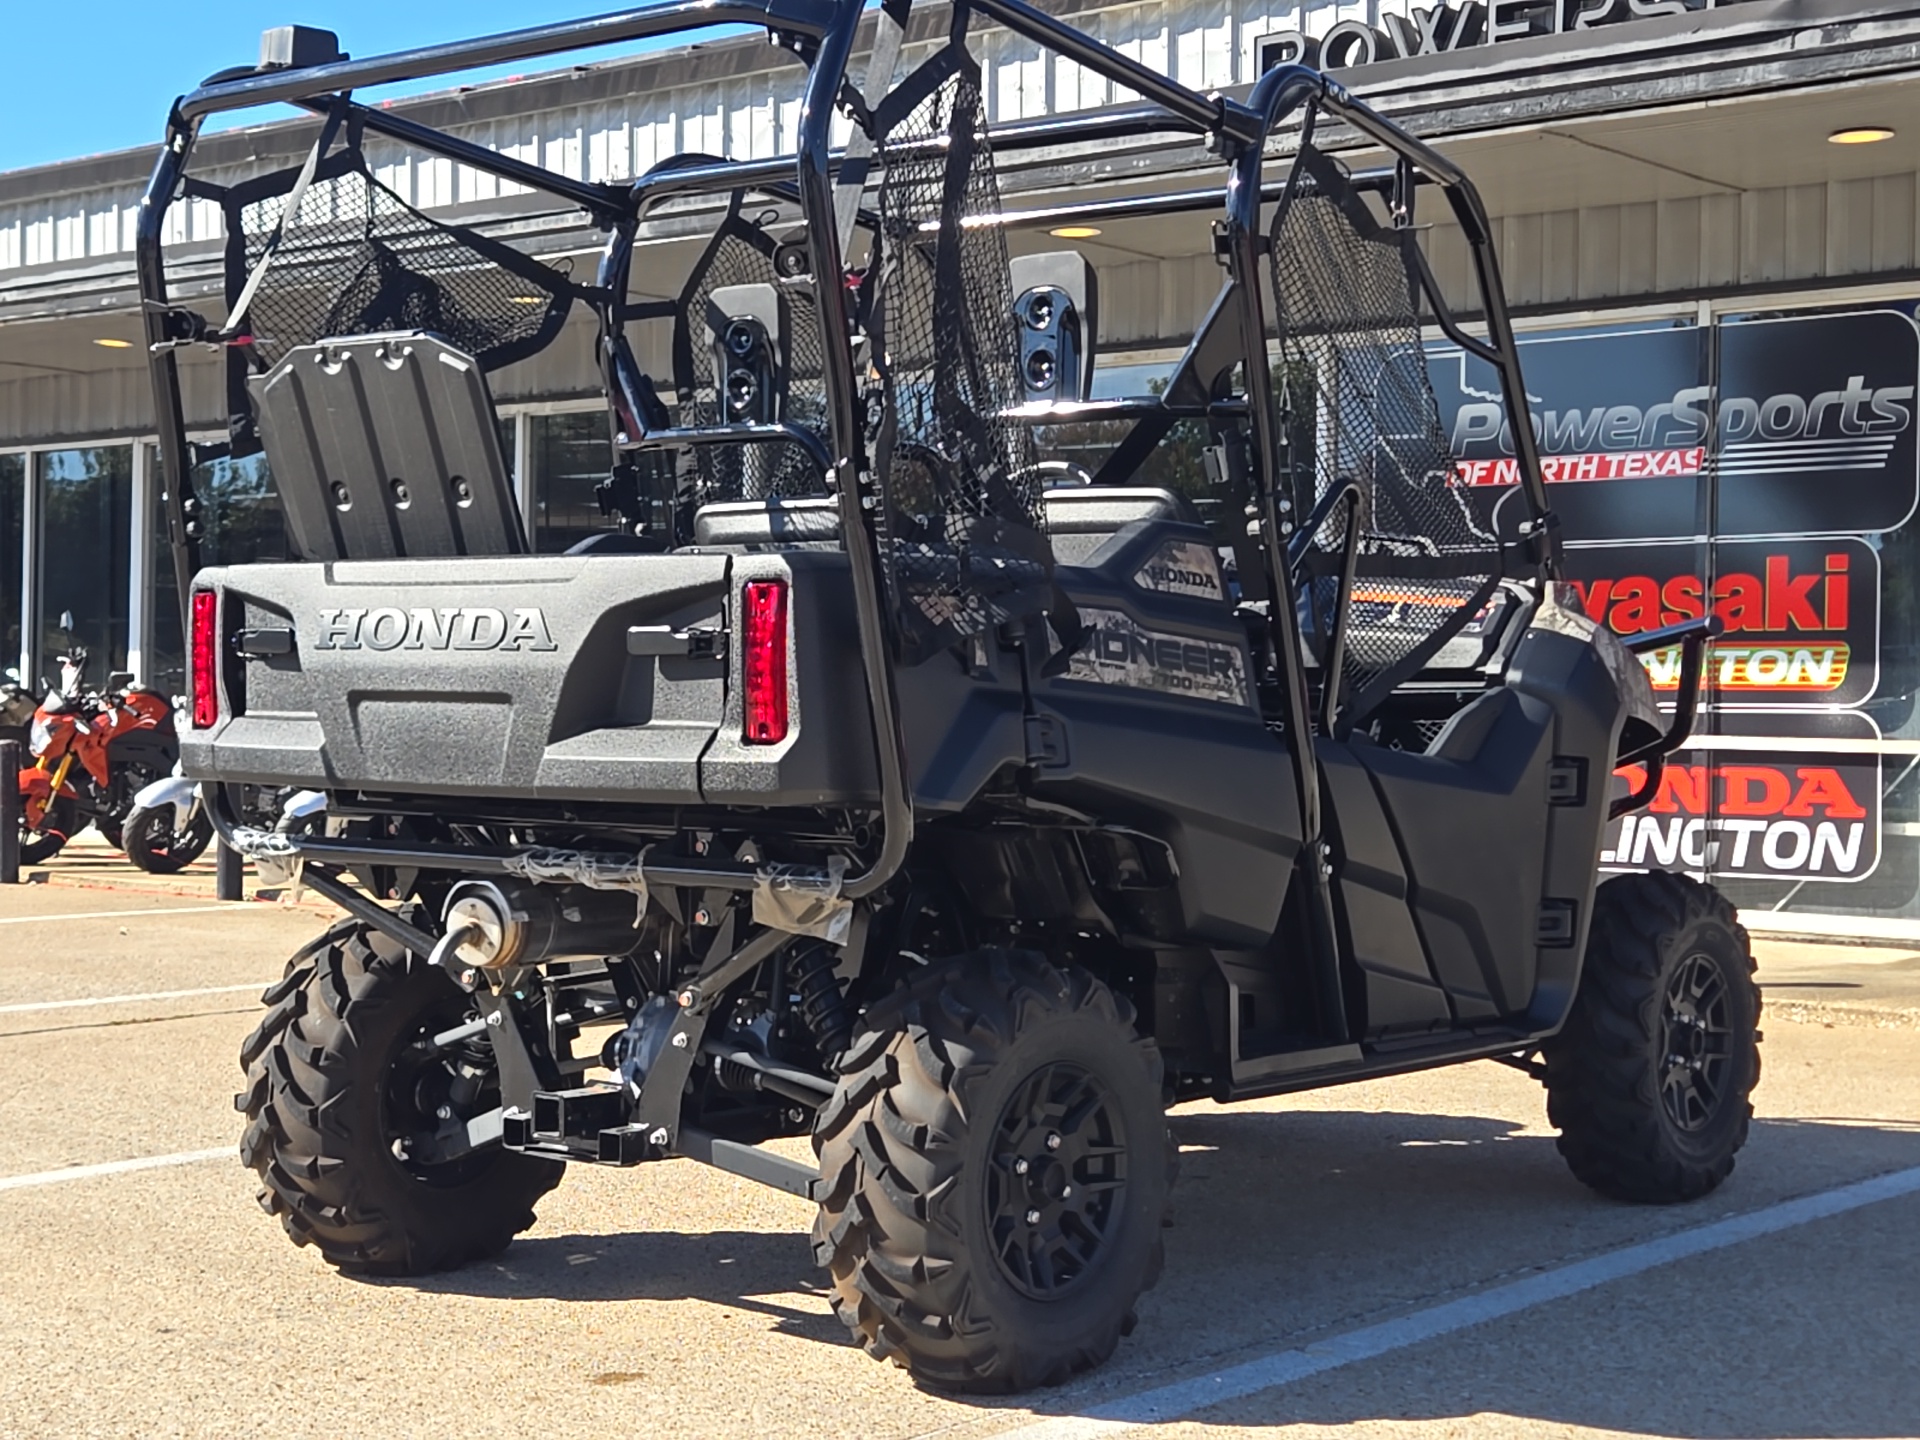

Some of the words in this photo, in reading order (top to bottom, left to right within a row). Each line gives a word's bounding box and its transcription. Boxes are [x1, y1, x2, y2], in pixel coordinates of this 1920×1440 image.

[1254, 0, 1716, 82] POWER
[1451, 375, 1914, 458] PowerSports
[1494, 455, 1598, 484] NRTH
[1605, 450, 1698, 478] TEXAS
[1149, 565, 1217, 590] HONDA
[315, 607, 558, 651] HONDA
[1089, 628, 1238, 681] IONEER
[1612, 762, 1867, 818] NDA
[1600, 816, 1865, 872] INGTON
